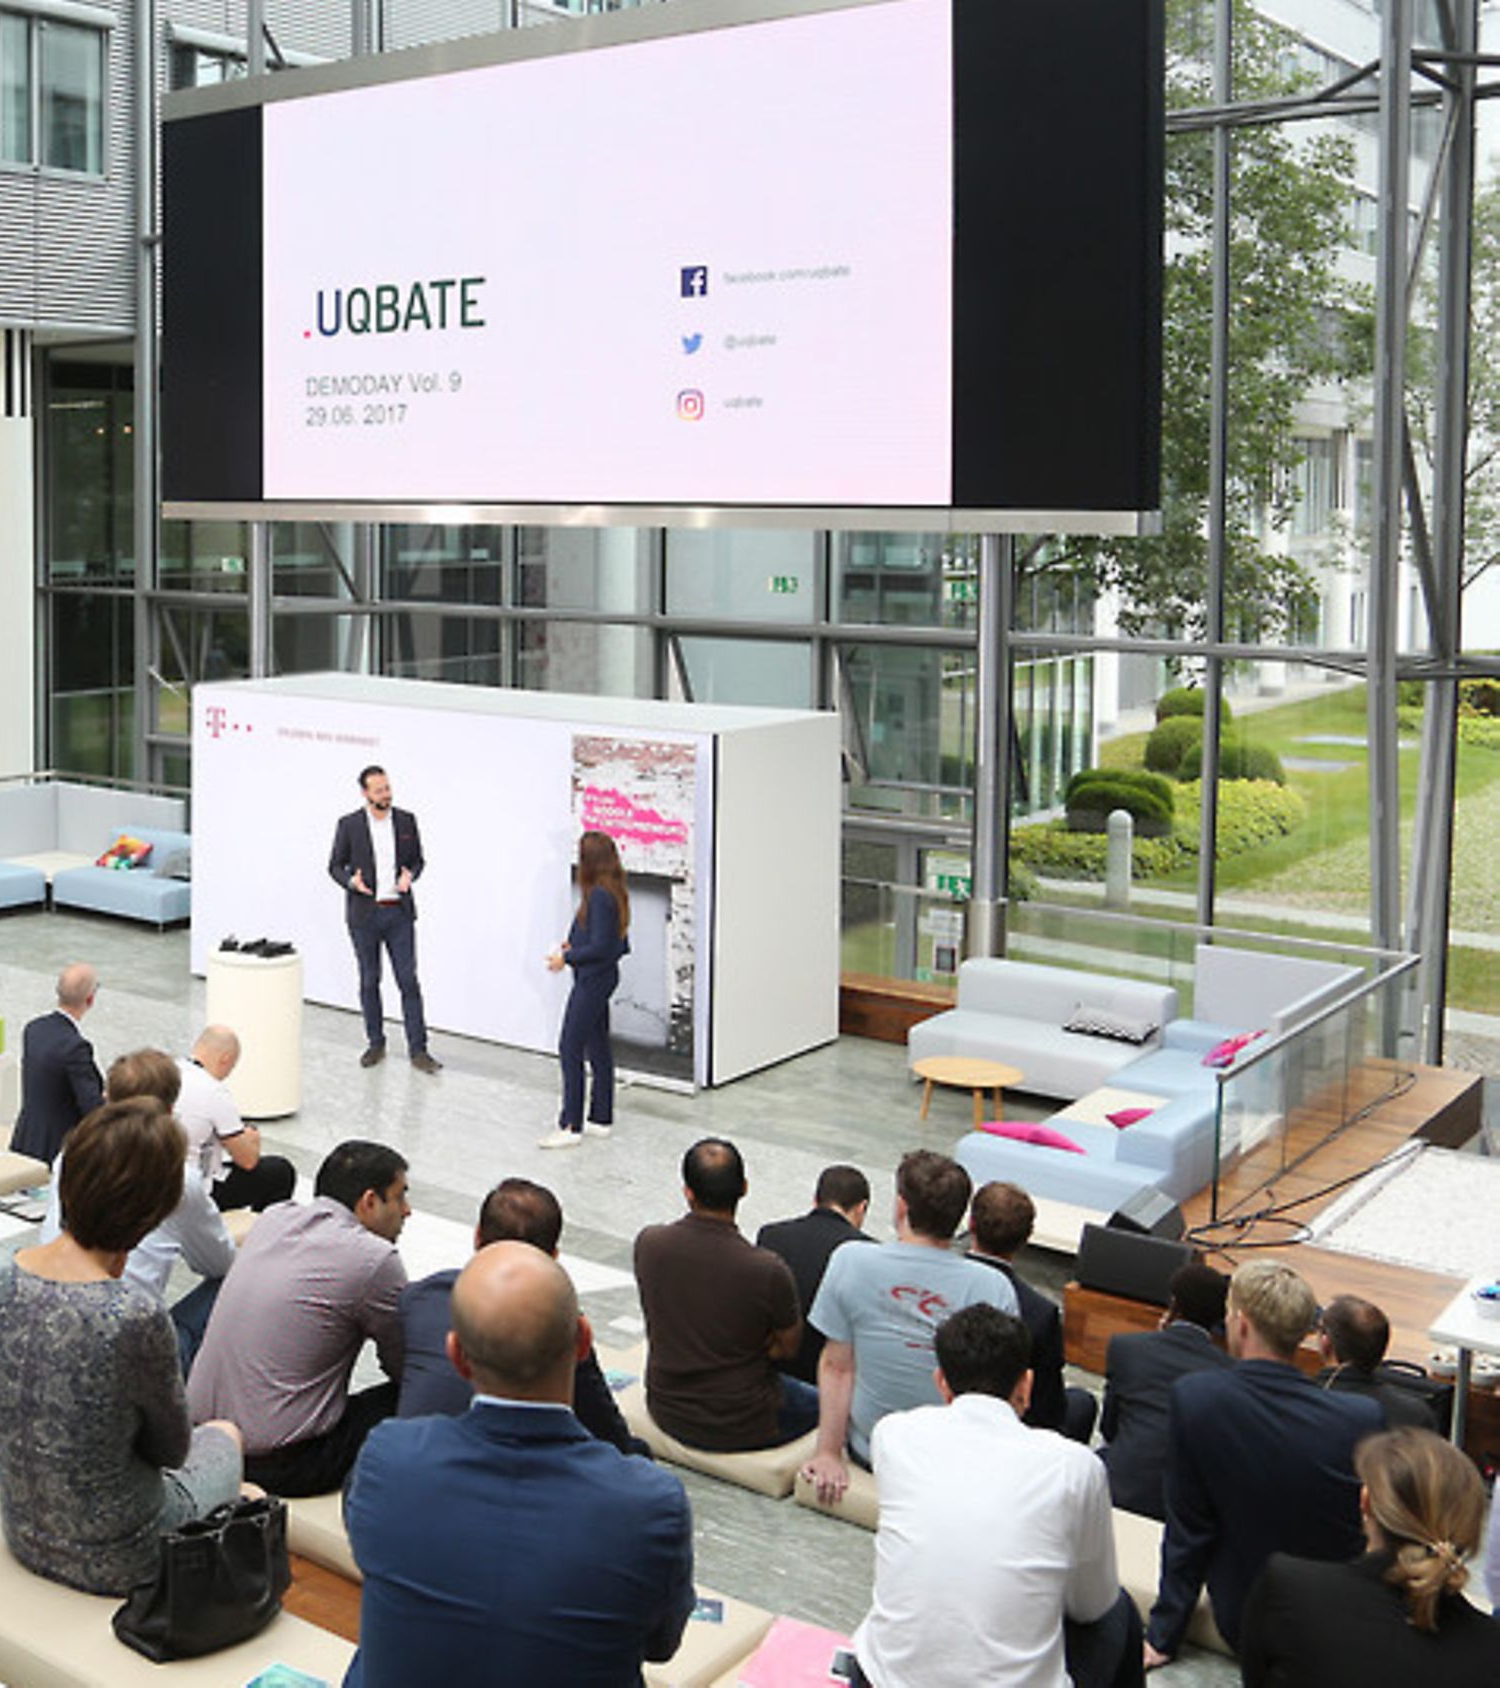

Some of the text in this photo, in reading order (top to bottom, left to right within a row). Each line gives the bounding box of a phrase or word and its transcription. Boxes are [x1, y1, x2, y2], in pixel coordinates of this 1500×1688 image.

[305, 370, 463, 397] DEMODAY Vol. 9
[306, 402, 408, 427] 29.06. 2017
